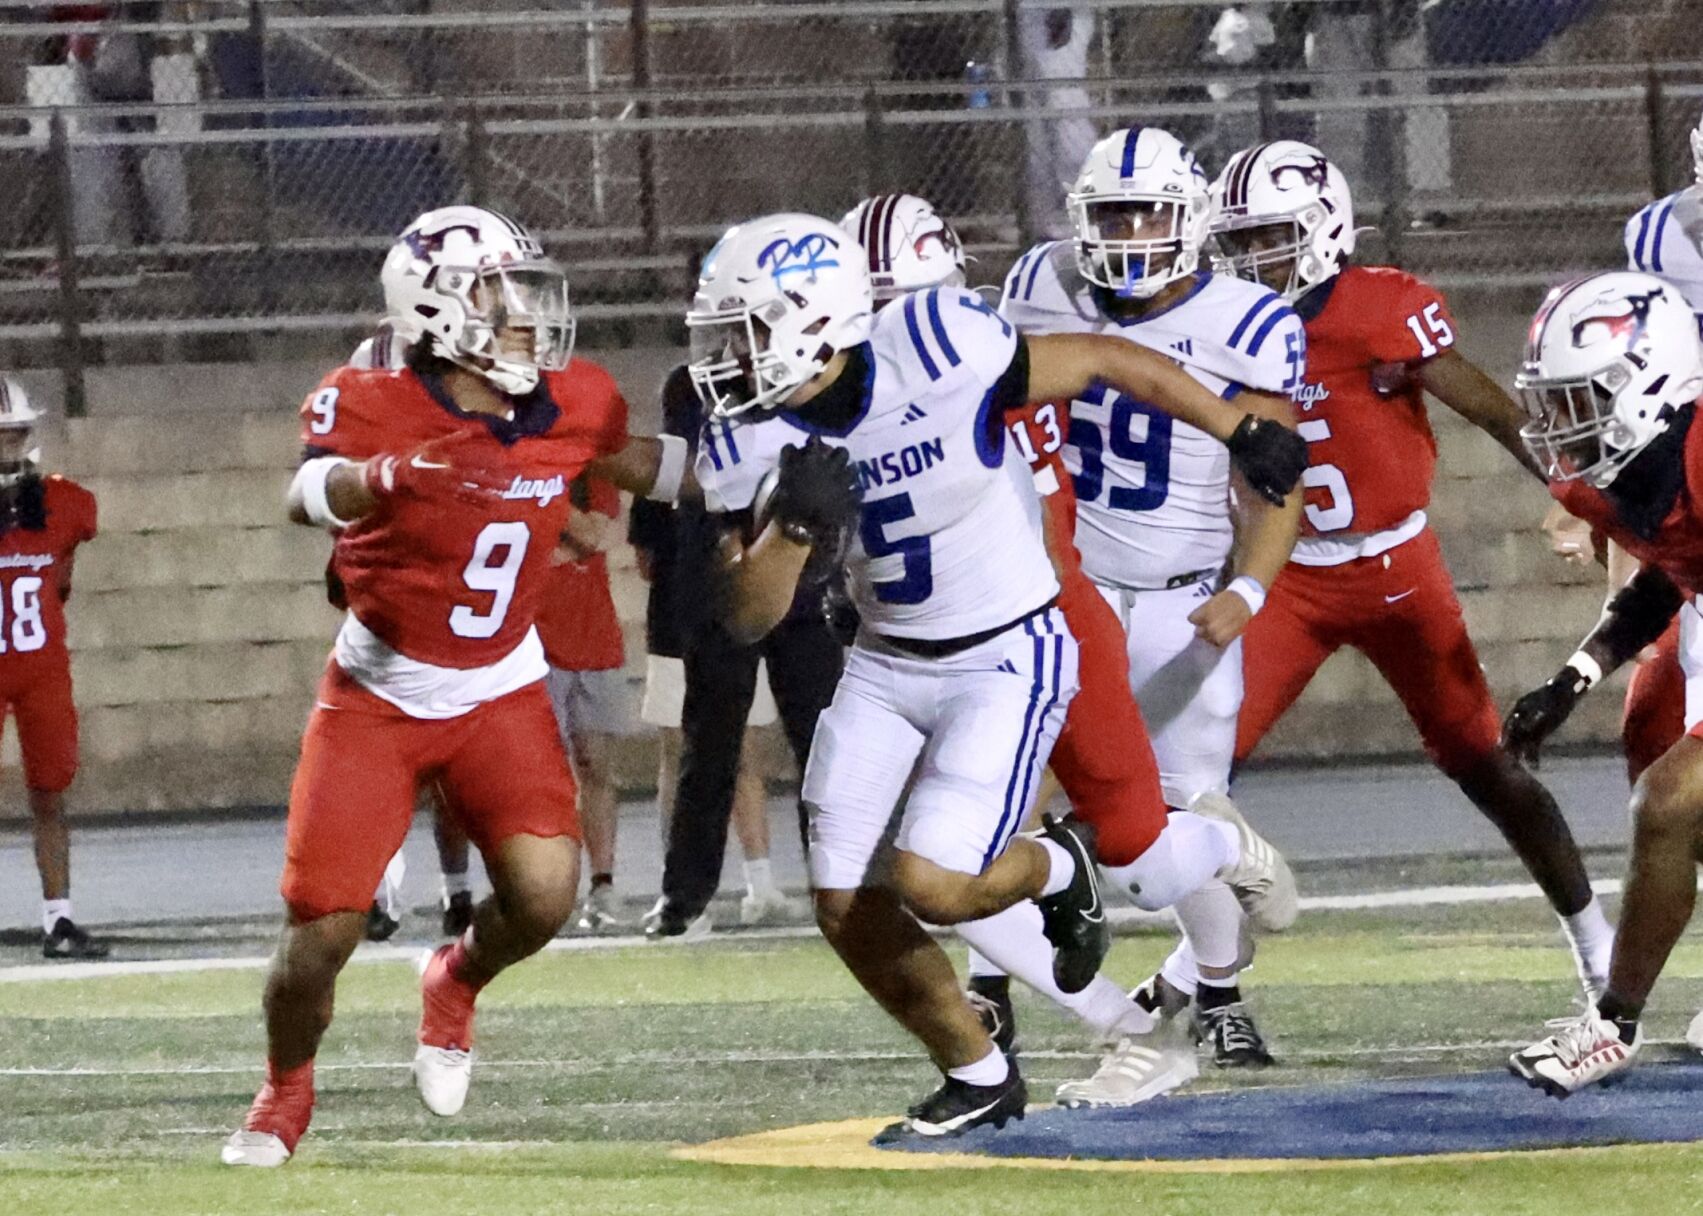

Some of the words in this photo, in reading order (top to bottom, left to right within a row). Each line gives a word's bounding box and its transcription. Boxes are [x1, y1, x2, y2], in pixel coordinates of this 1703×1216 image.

[1406, 301, 1454, 358] 15
[310, 387, 340, 435] 9
[1011, 403, 1061, 463] 13
[858, 491, 934, 605] 5
[448, 521, 531, 638] 9
